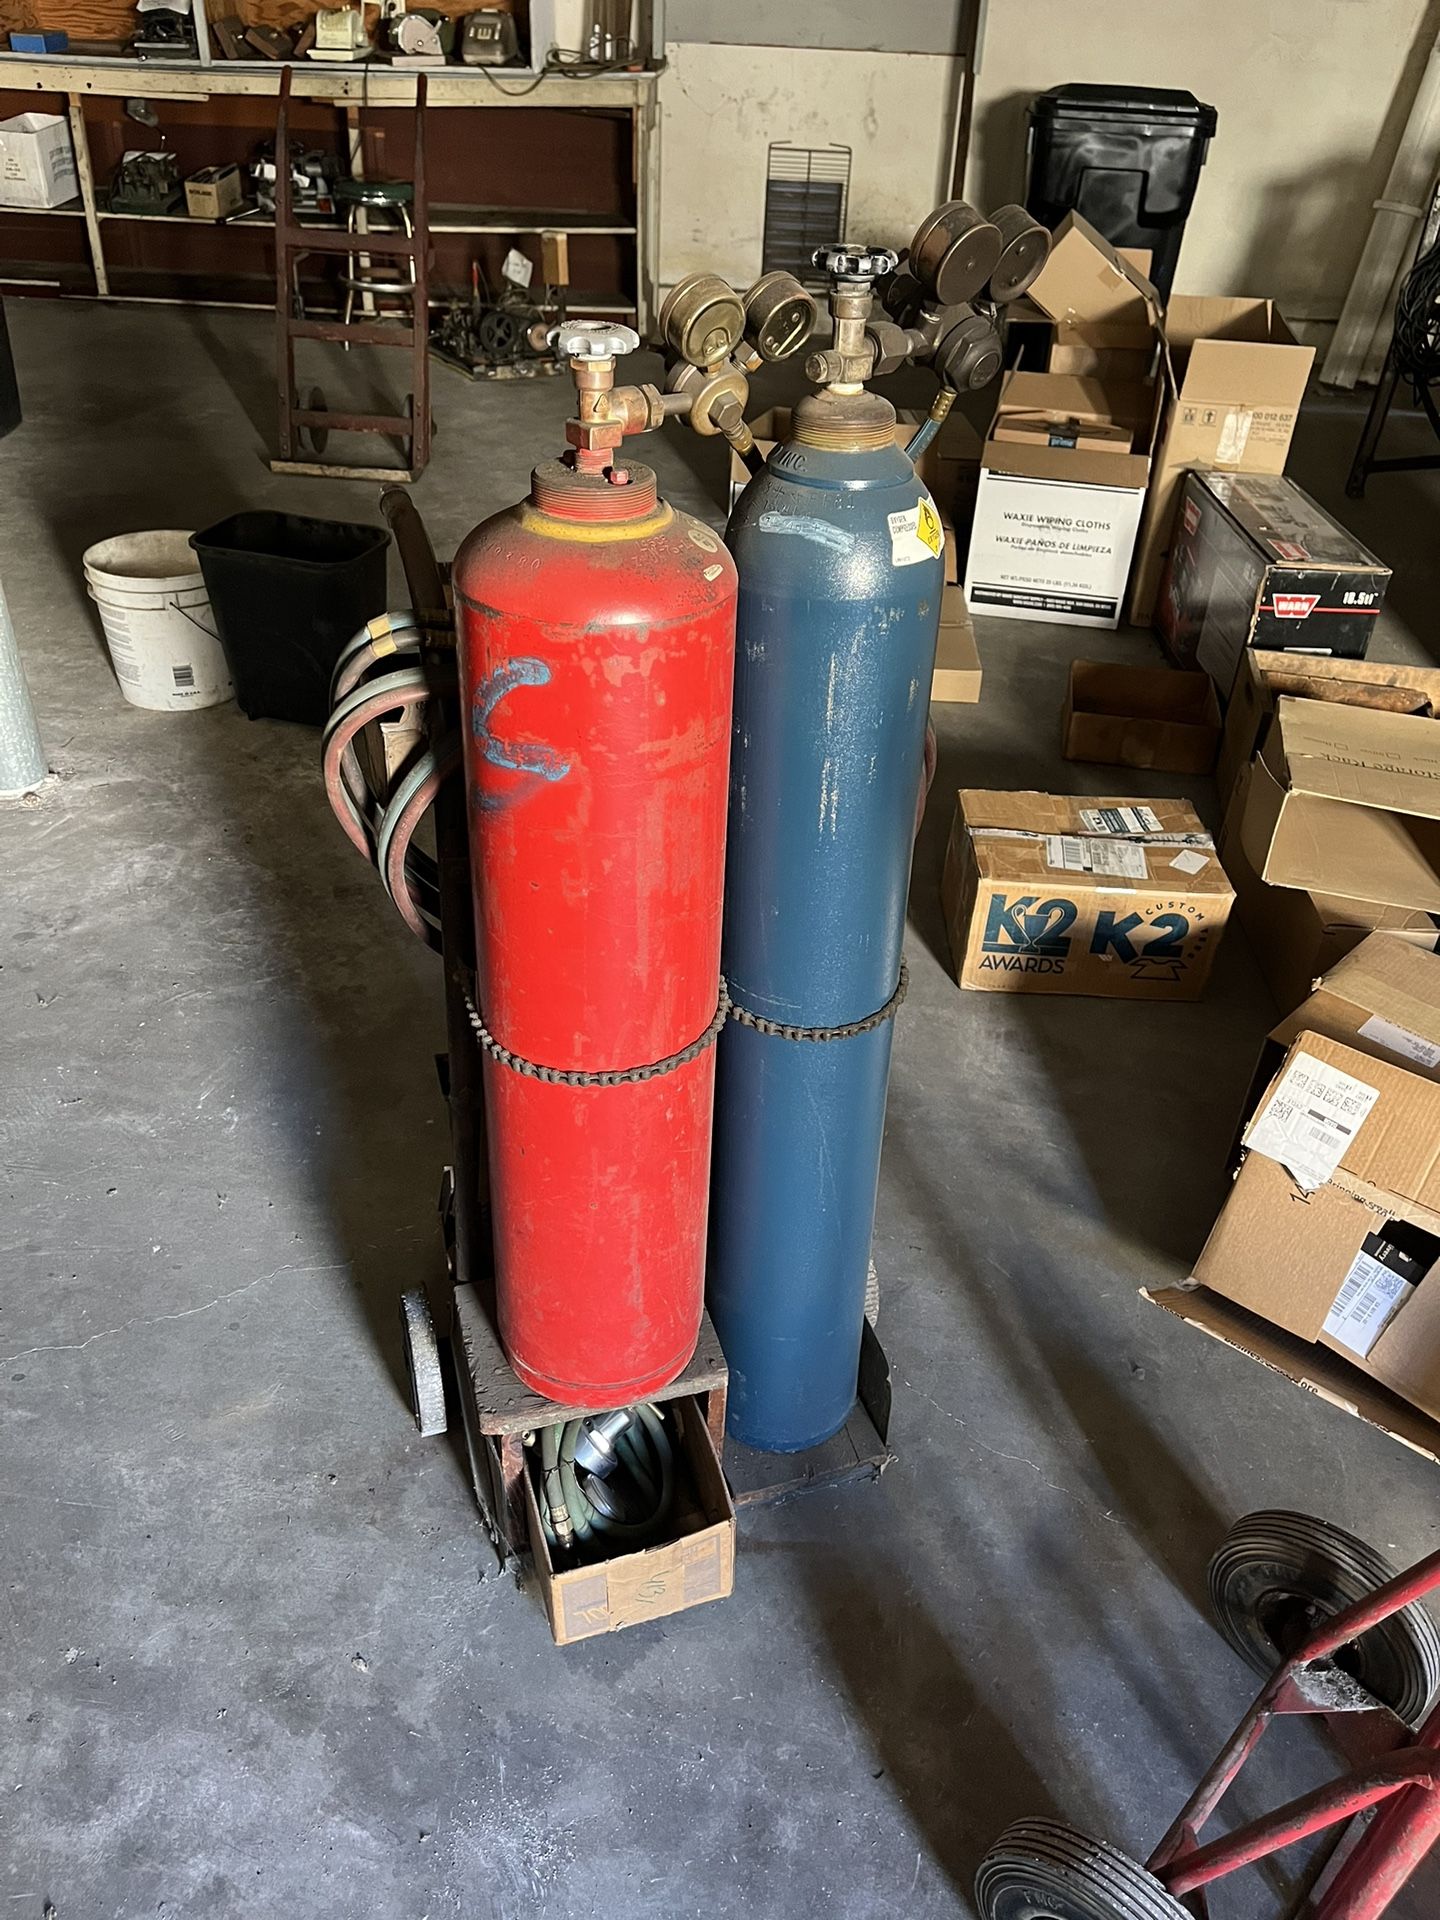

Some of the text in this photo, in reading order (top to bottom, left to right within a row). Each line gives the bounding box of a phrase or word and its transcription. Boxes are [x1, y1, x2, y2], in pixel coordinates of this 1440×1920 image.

[1003, 511, 1112, 531] WAXIE WIPING CLOTHS
[995, 534, 1024, 545] WAXIE
[1024, 537, 1057, 549] PAÑOS
[1058, 541, 1071, 551] DE
[1072, 543, 1113, 555] LIMPIEZA
[1145, 901, 1206, 921] CUSTOM
[980, 893, 1078, 957] K2
[1090, 911, 1190, 965] K2
[979, 954, 1066, 975] AWARDS
